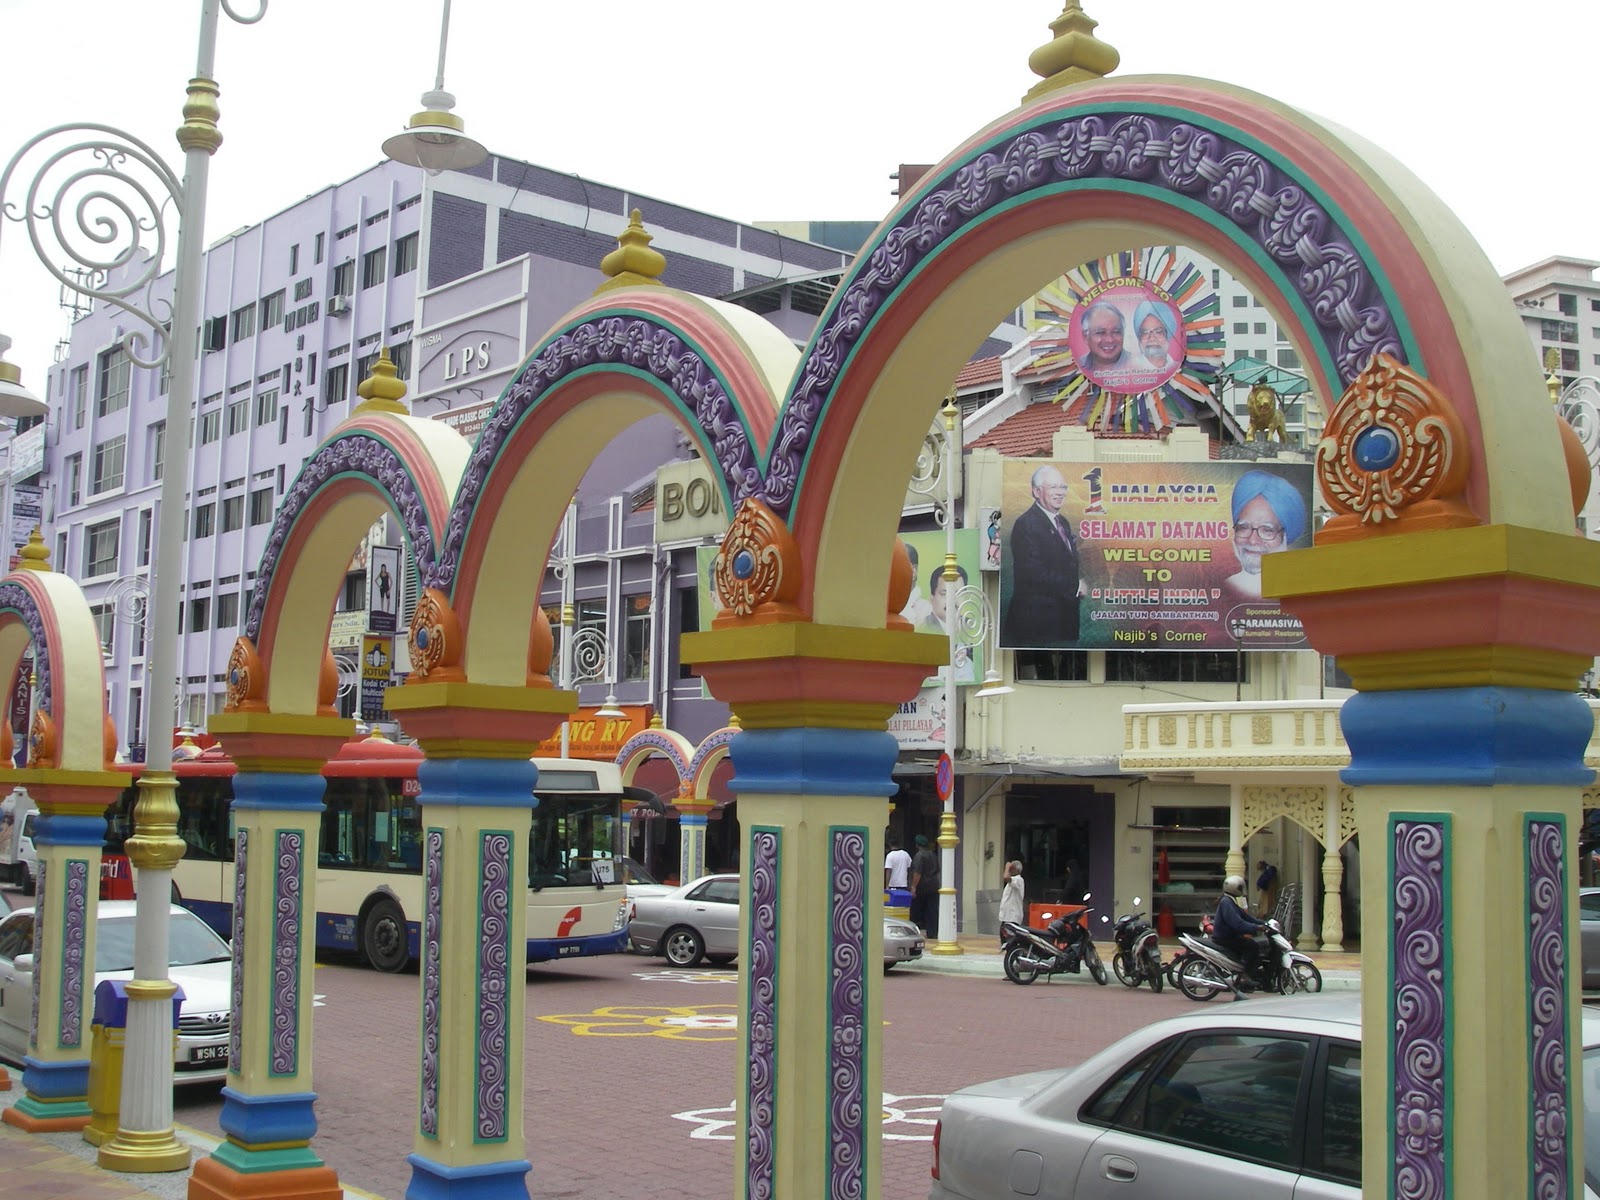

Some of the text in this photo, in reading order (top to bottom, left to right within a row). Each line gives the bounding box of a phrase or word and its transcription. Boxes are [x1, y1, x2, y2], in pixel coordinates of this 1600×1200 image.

[1080, 277, 1170, 307] WELCOME TO
[421, 334, 442, 348] WISMA
[444, 341, 490, 380] LPS
[459, 410, 478, 425] CLASSIC
[1111, 484, 1218, 503] MALAYSIA
[1080, 521, 1229, 539] SELAMAT DATANG
[1103, 548, 1212, 562] WELCOME
[1142, 569, 1172, 582] TO
[1128, 611, 1149, 620] TUN
[1245, 608, 1281, 616] Sponsored
[1114, 630, 1208, 643] Najib's Corner
[363, 668, 390, 676] JOTUN
[363, 679, 378, 687] Kedai
[362, 688, 384, 697] Multicol
[896, 702, 917, 714] RAN
[545, 719, 632, 742] ANG RV
[889, 719, 933, 731] LAI PILLAYAR
[597, 865, 610, 873] U75
[196, 1047, 216, 1060] WSN
